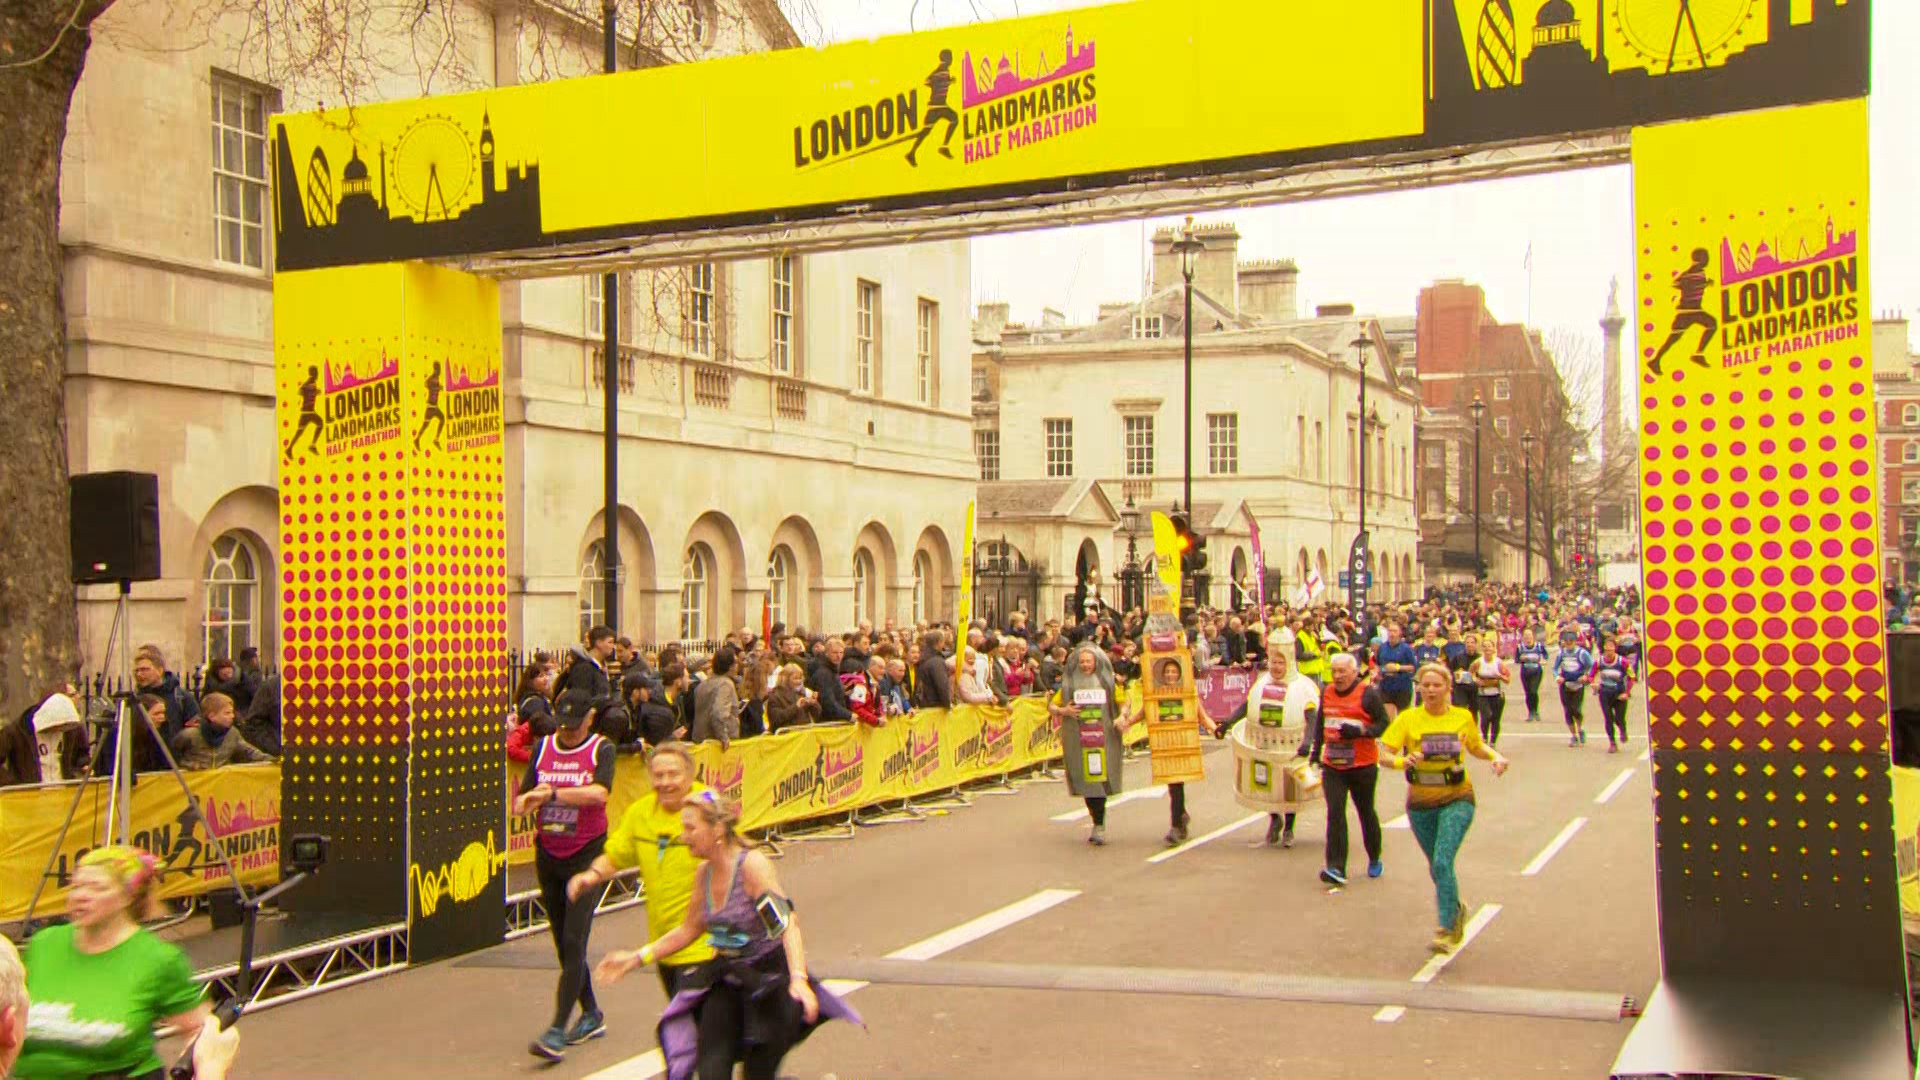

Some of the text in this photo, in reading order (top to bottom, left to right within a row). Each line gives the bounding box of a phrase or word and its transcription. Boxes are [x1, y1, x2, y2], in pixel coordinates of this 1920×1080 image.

[962, 74, 1096, 140] LANDMARKS
[793, 88, 918, 168] LONDON
[963, 103, 1097, 164] HALF MARATHON
[1721, 256, 1857, 324] LONDON
[1722, 297, 1858, 350] LANDMARKS
[1722, 323, 1858, 368] HALF MARATHON
[325, 377, 400, 423] LONDON
[446, 387, 499, 419] LONDON
[326, 407, 400, 443] LANDMARKS
[326, 427, 400, 456] HALF MARATHON
[447, 415, 500, 439] LANDMARKS
[447, 433, 500, 453] HALF MARATHON
[538, 770, 594, 786] Tommy's
[552, 761, 579, 770] Team
[772, 766, 813, 807] LONDON
